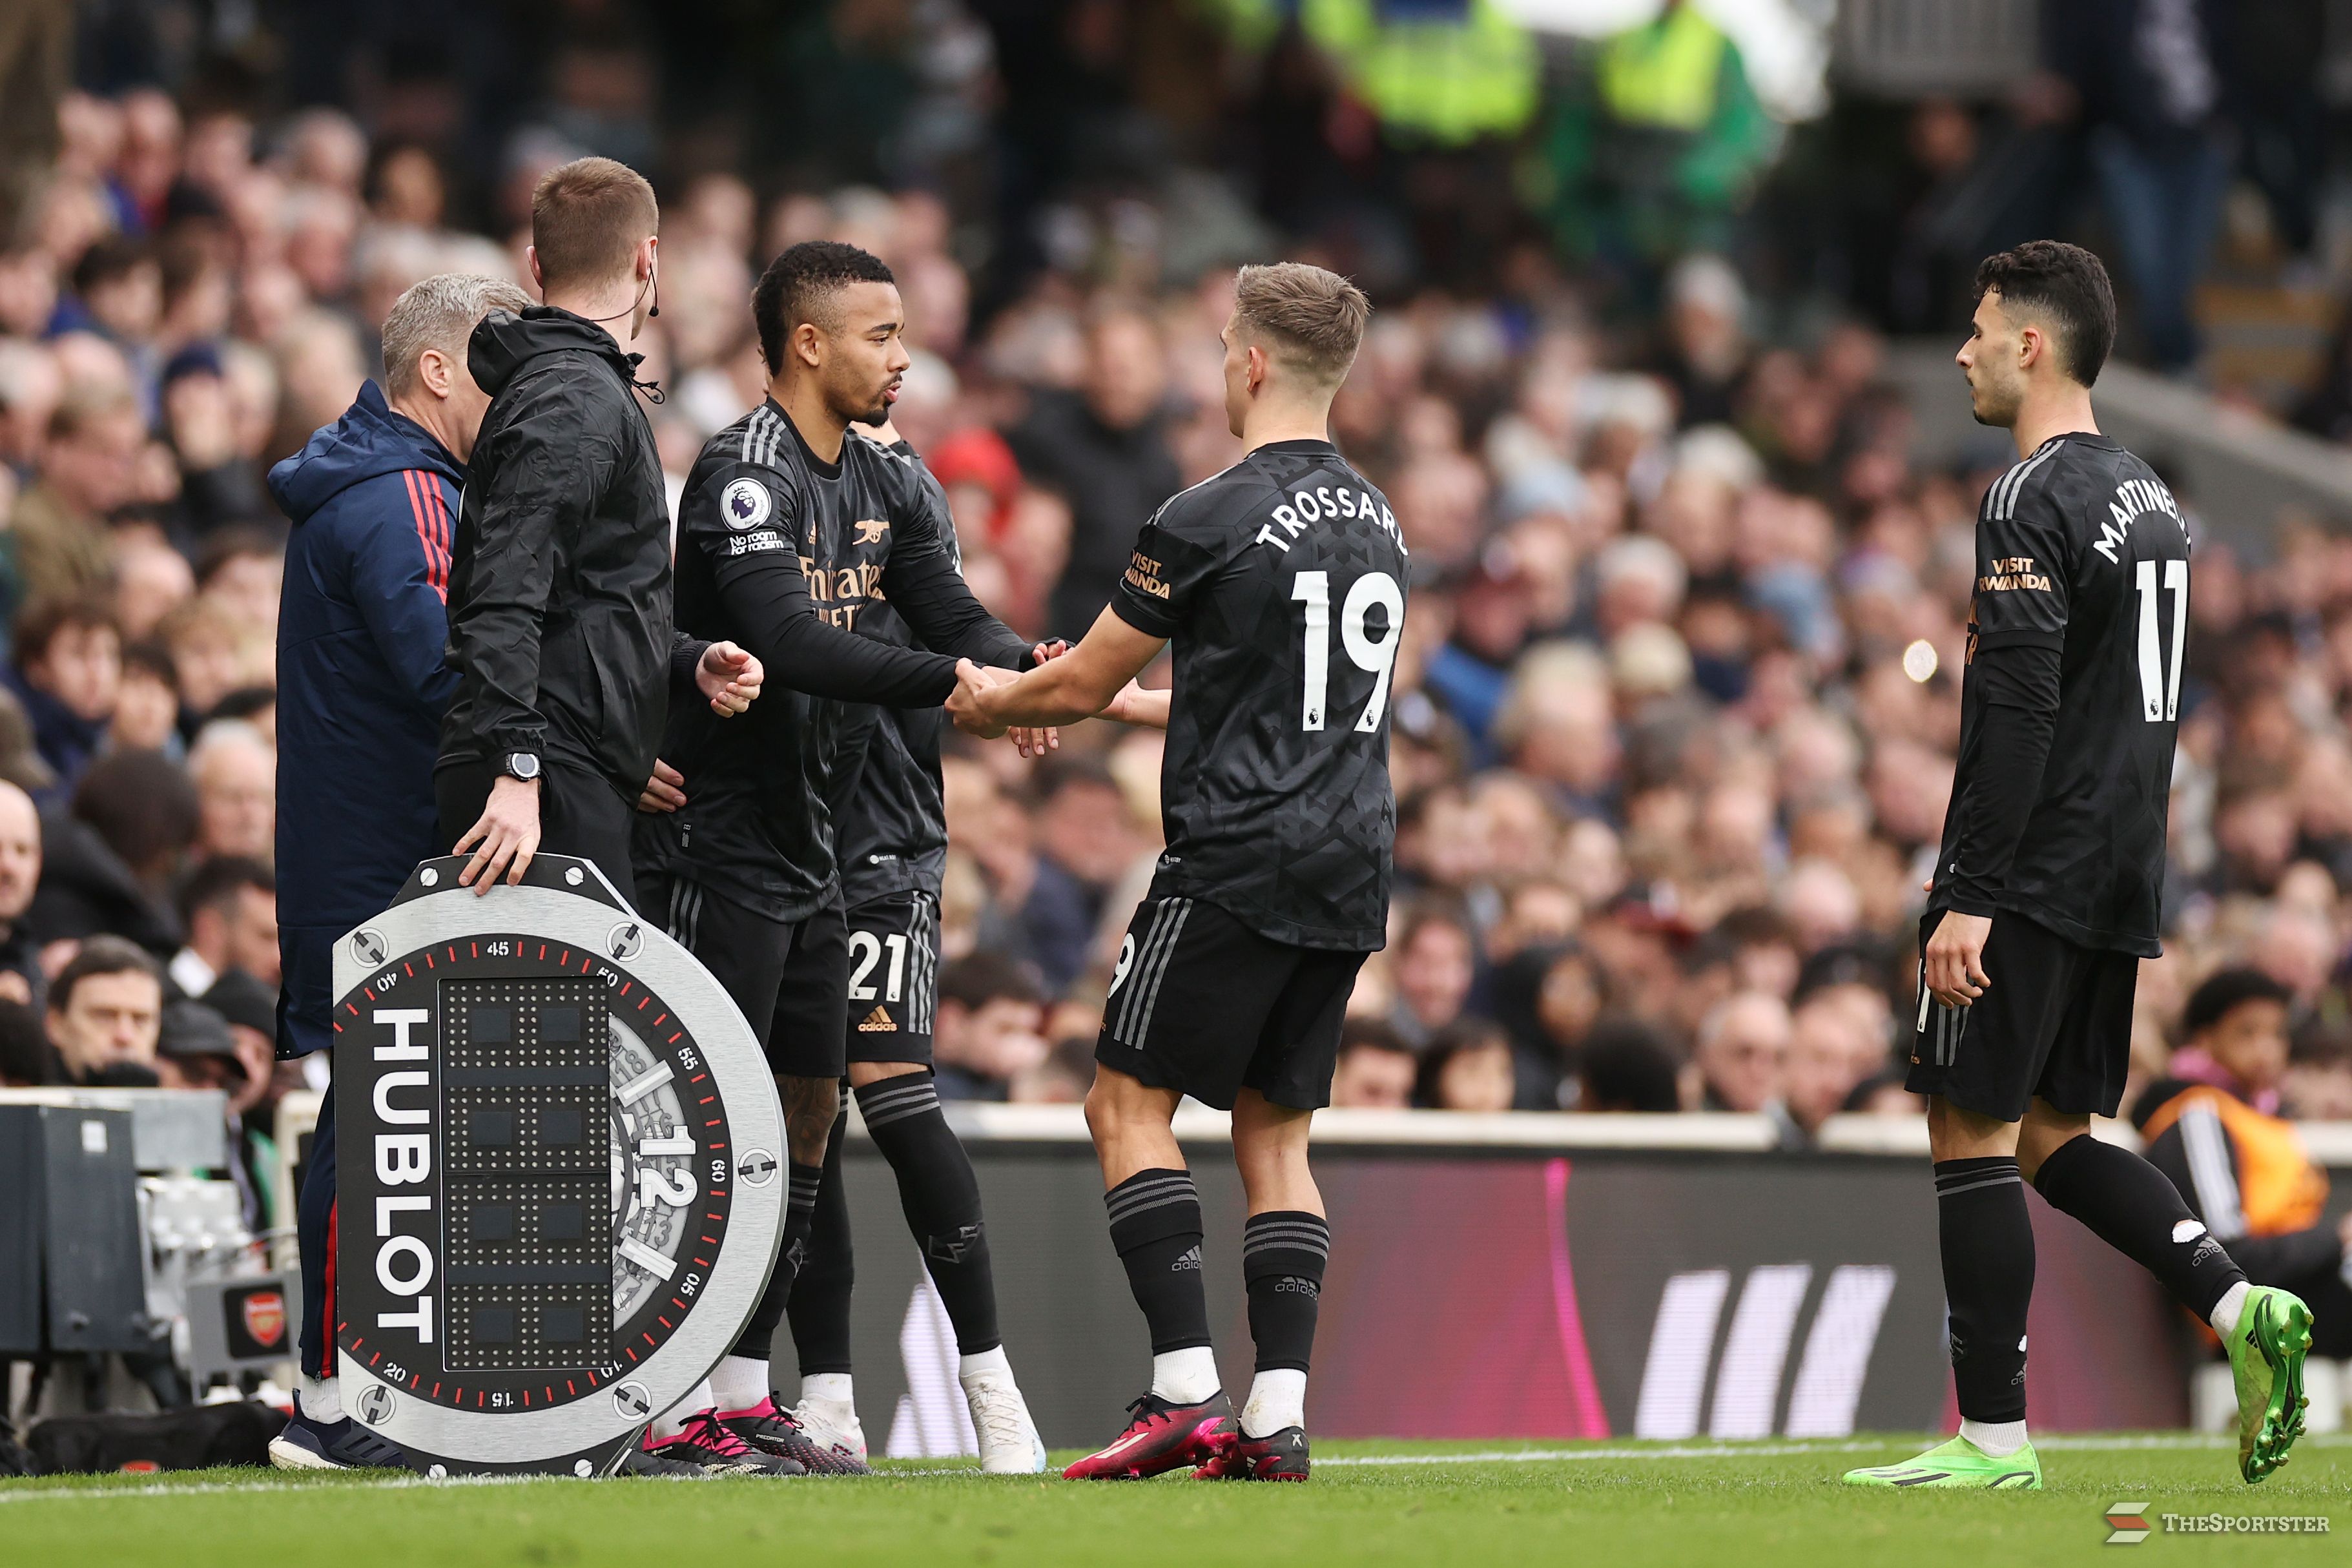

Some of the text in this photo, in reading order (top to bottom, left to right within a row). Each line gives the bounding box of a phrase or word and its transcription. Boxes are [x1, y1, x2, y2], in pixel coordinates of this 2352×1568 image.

[2093, 479, 2191, 564] MARTINEL
[729, 531, 778, 547] No room
[731, 539, 784, 555] for racism
[1132, 548, 1162, 576] VISIT
[1992, 557, 2034, 574] VISIT
[1979, 573, 2052, 593] RWANDA
[2136, 559, 2188, 722] 11
[1291, 571, 1404, 733] 19
[487, 941, 509, 956] 45
[596, 966, 619, 987] 50
[849, 931, 907, 1002] 21
[377, 972, 397, 992] 40
[858, 1020, 898, 1033] adidas
[678, 1047, 699, 1071] 55
[372, 1008, 433, 1343] HUBLOT
[639, 1125, 698, 1208] 12
[711, 1159, 726, 1182] 60
[1171, 1259, 1202, 1272] adid
[2192, 1246, 2223, 1267] adid
[680, 1273, 700, 1296] 05
[383, 1362, 406, 1382] 20
[601, 1359, 623, 1378] 10
[492, 1392, 514, 1407] 15
[756, 1433, 785, 1443] PREDATOR
